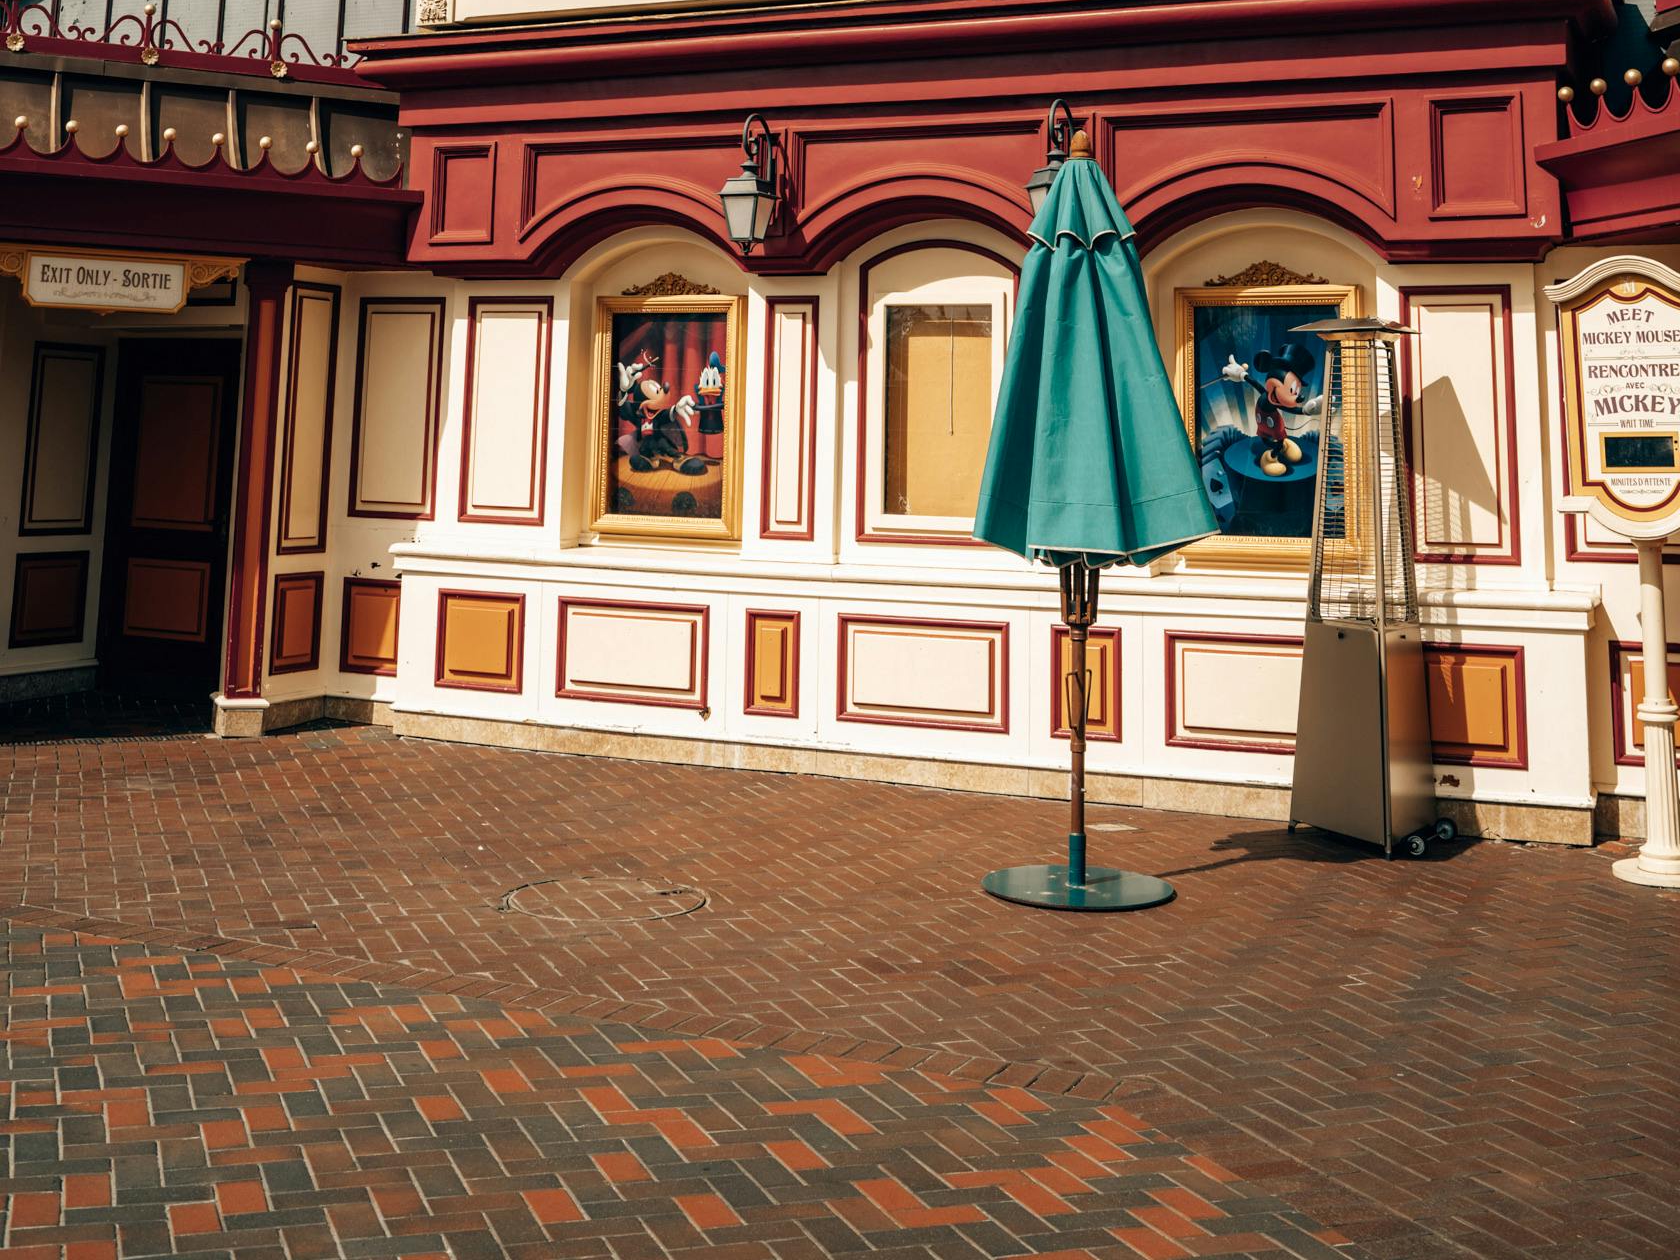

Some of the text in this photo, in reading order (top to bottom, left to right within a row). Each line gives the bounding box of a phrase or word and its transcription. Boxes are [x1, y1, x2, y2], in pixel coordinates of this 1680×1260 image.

[40, 264, 73, 284] EXIT
[76, 266, 112, 287] ONLY
[121, 269, 172, 290] SORTIE
[1606, 308, 1655, 326] MEET
[1582, 329, 1680, 345] MICKEY MOUSE
[1587, 363, 1680, 379] RENCONTRE
[1625, 381, 1645, 389] AVEC
[1593, 394, 1680, 418] MICKEY
[1619, 419, 1655, 429] WAIT TIME
[1610, 477, 1638, 486] MINUTES
